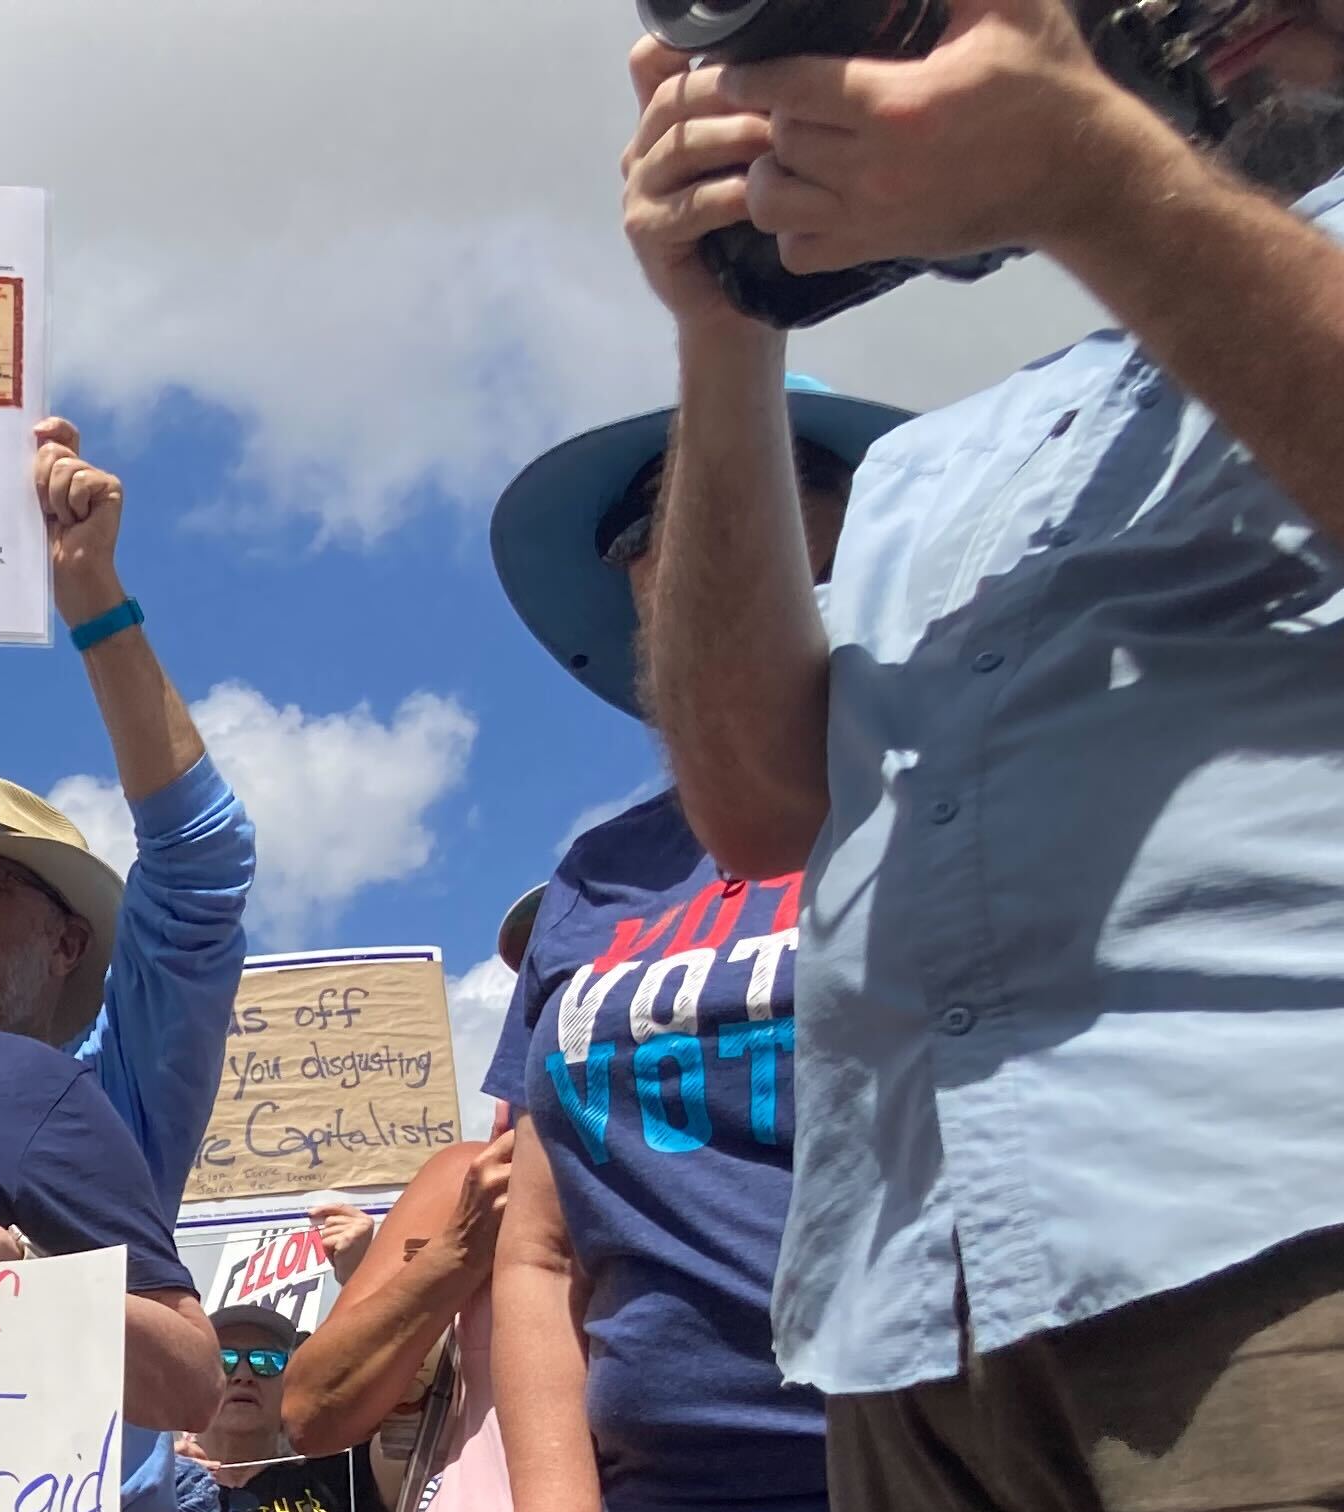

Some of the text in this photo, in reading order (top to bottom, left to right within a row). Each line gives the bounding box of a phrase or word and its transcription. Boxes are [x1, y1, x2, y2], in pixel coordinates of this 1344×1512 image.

[295, 987, 370, 1031] off
[301, 1041, 433, 1090] disgusting
[244, 1100, 455, 1170] Capitalists
